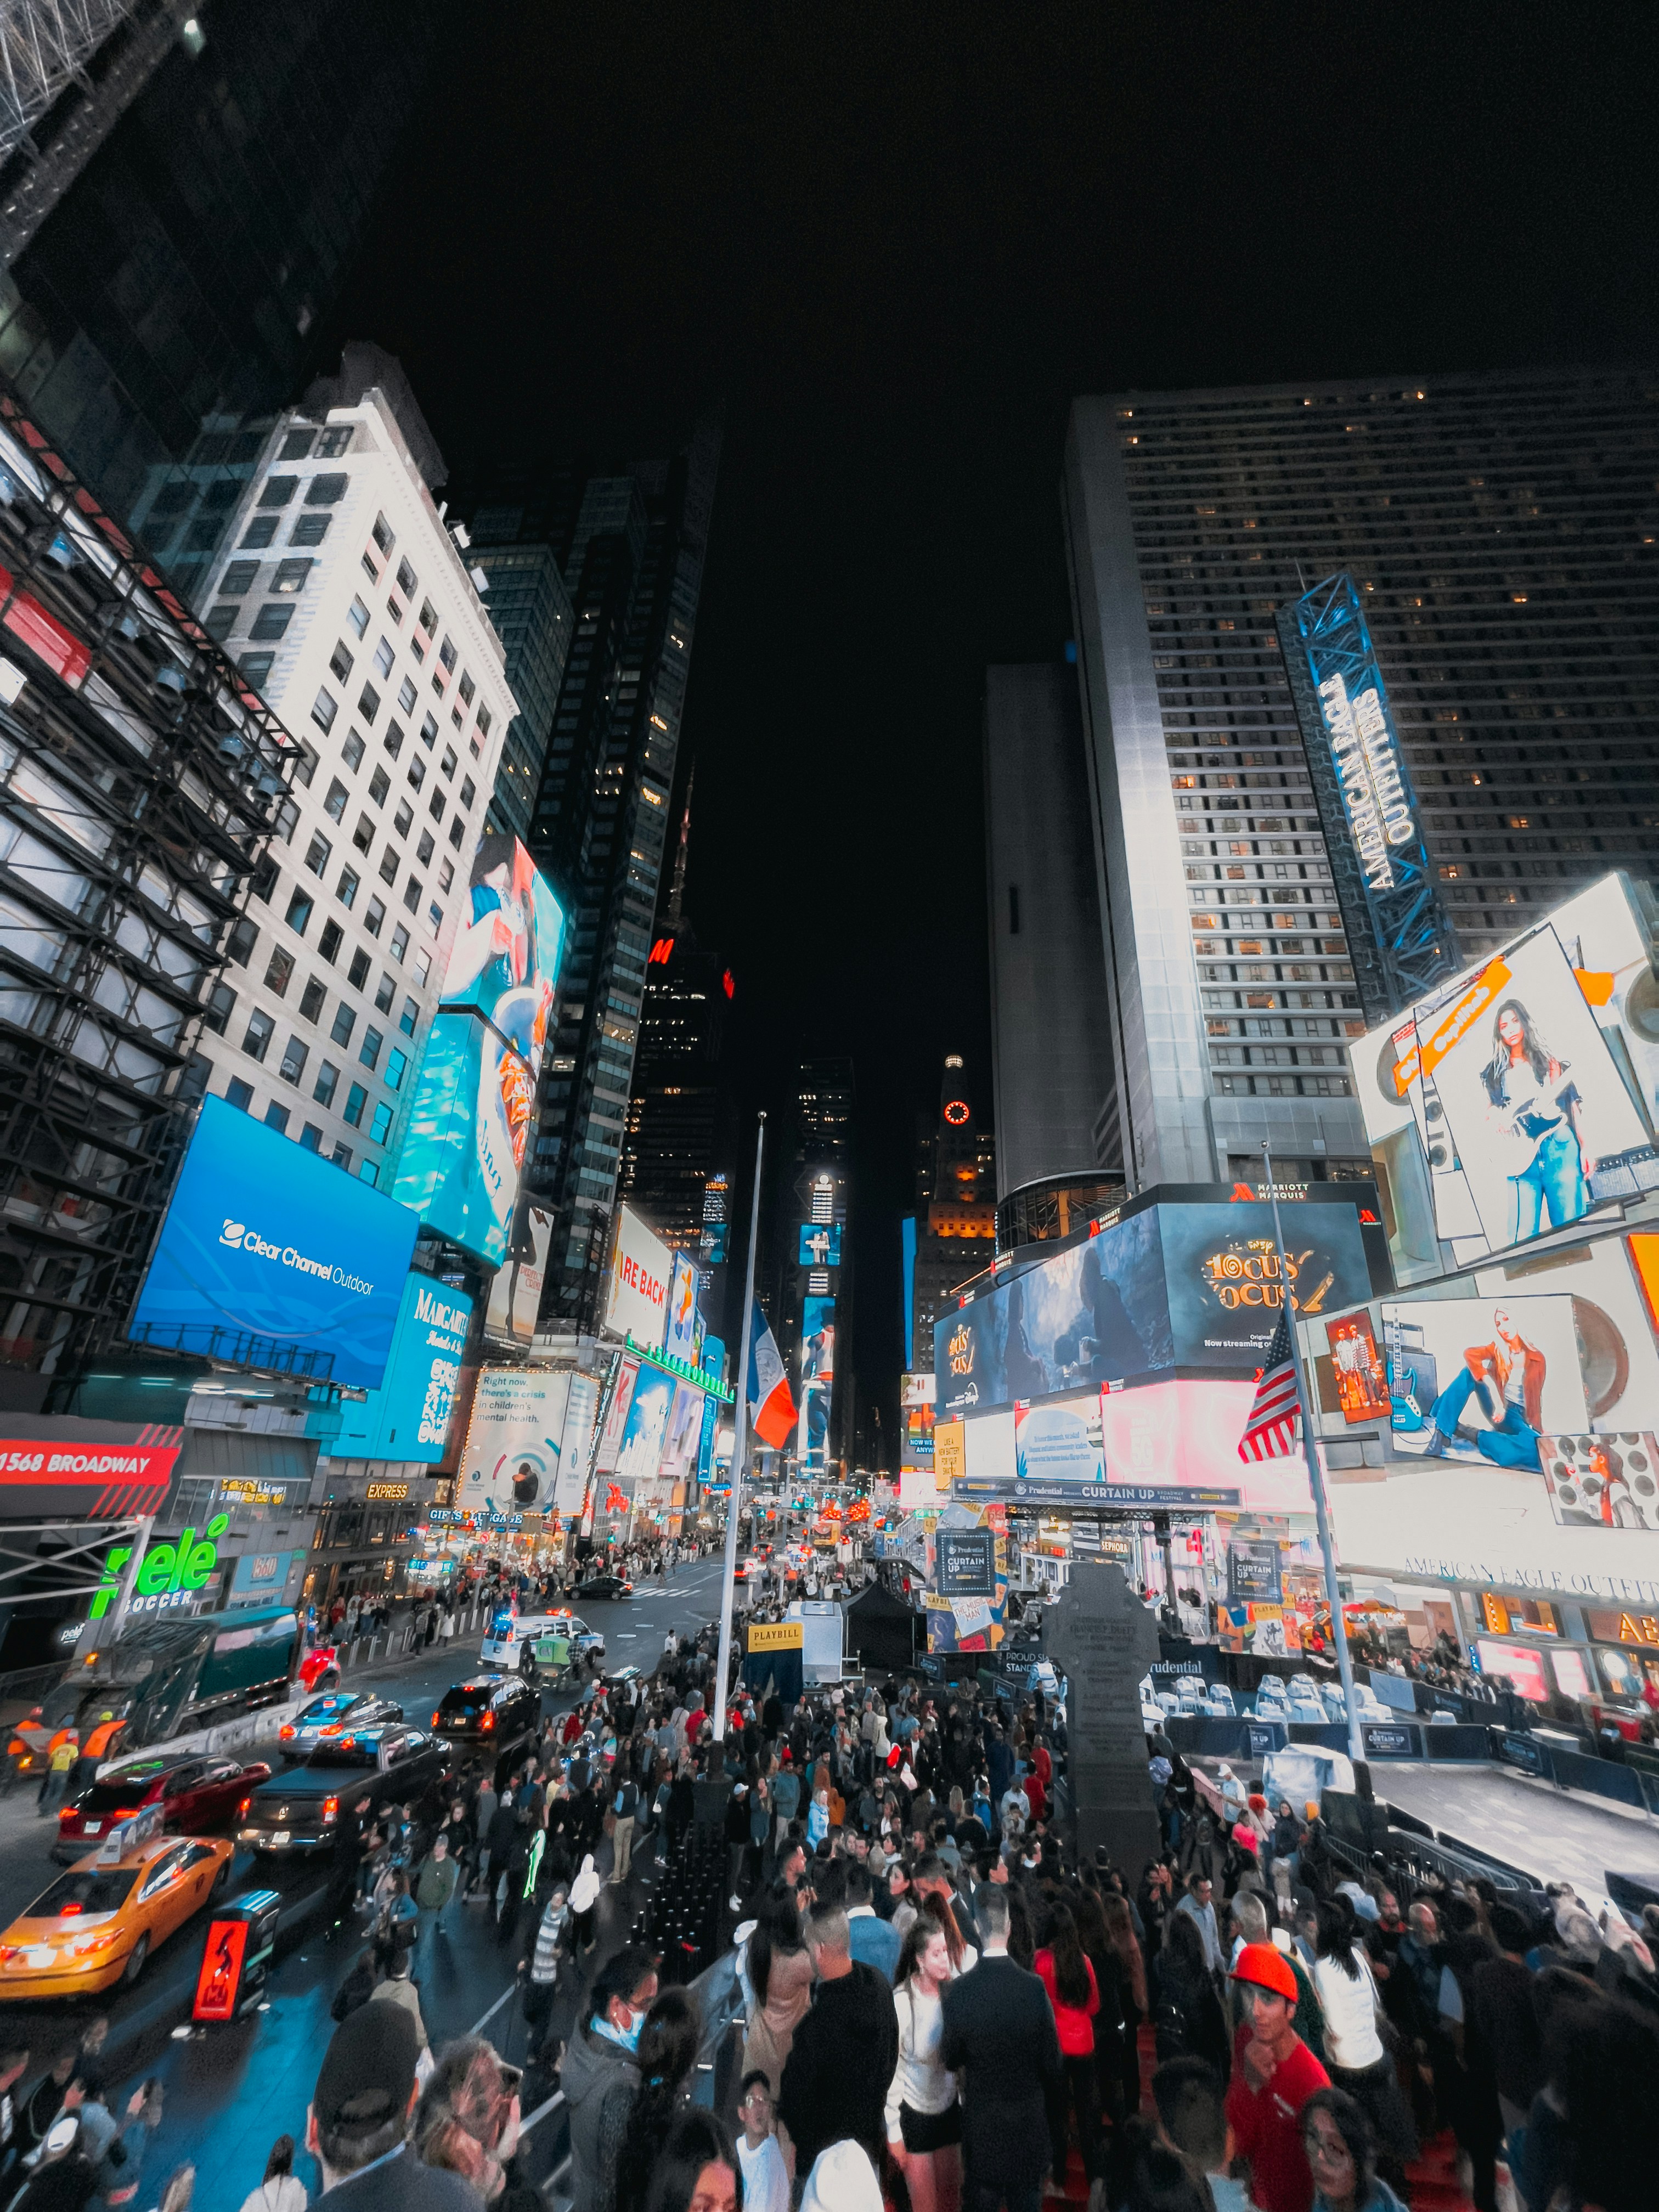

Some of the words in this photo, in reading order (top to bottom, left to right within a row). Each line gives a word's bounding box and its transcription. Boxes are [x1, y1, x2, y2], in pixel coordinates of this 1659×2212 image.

[1319, 672, 1357, 753] EAGLE
[1353, 688, 1414, 845] OUTFITTERS
[1339, 751, 1395, 889] AMERICAN
[244, 1232, 282, 1260] Clear
[283, 1247, 332, 1280] Channel
[333, 1267, 374, 1295] Outdoor
[1209, 1282, 1300, 1310] OCUS
[1223, 1340, 1263, 1348] streaming
[483, 1376, 506, 1386] Right
[677, 1362, 726, 1396] BROADWAY
[481, 1389, 511, 1397] there's
[489, 1401, 531, 1410] children's
[477, 1413, 507, 1421] mental
[509, 1414, 539, 1423] health.
[0, 1453, 44, 1472] 1568
[47, 1454, 150, 1474] BROADWAY
[367, 1484, 408, 1499] EXPRESS
[1029, 1486, 1062, 1495] Prudential
[1082, 1487, 1135, 1499] CURTAIN
[1139, 1489, 1155, 1500] UP
[470, 1512, 523, 1523] LUGAE
[1102, 1541, 1128, 1553] SEPHORA
[1237, 1565, 1272, 1573] CURTAIN
[1404, 1556, 1495, 1582] AMERICAN
[1499, 1565, 1566, 1590] EAGLE
[1571, 1573, 1659, 1602] OUTFIT
[123, 1590, 193, 1613] SOCCER
[954, 1605, 967, 1617] THE
[967, 1598, 986, 1609] MUSIC
[965, 1608, 980, 1621] MAN
[754, 1629, 799, 1640] PLAYBILL
[1007, 1652, 1035, 1661] PROUD
